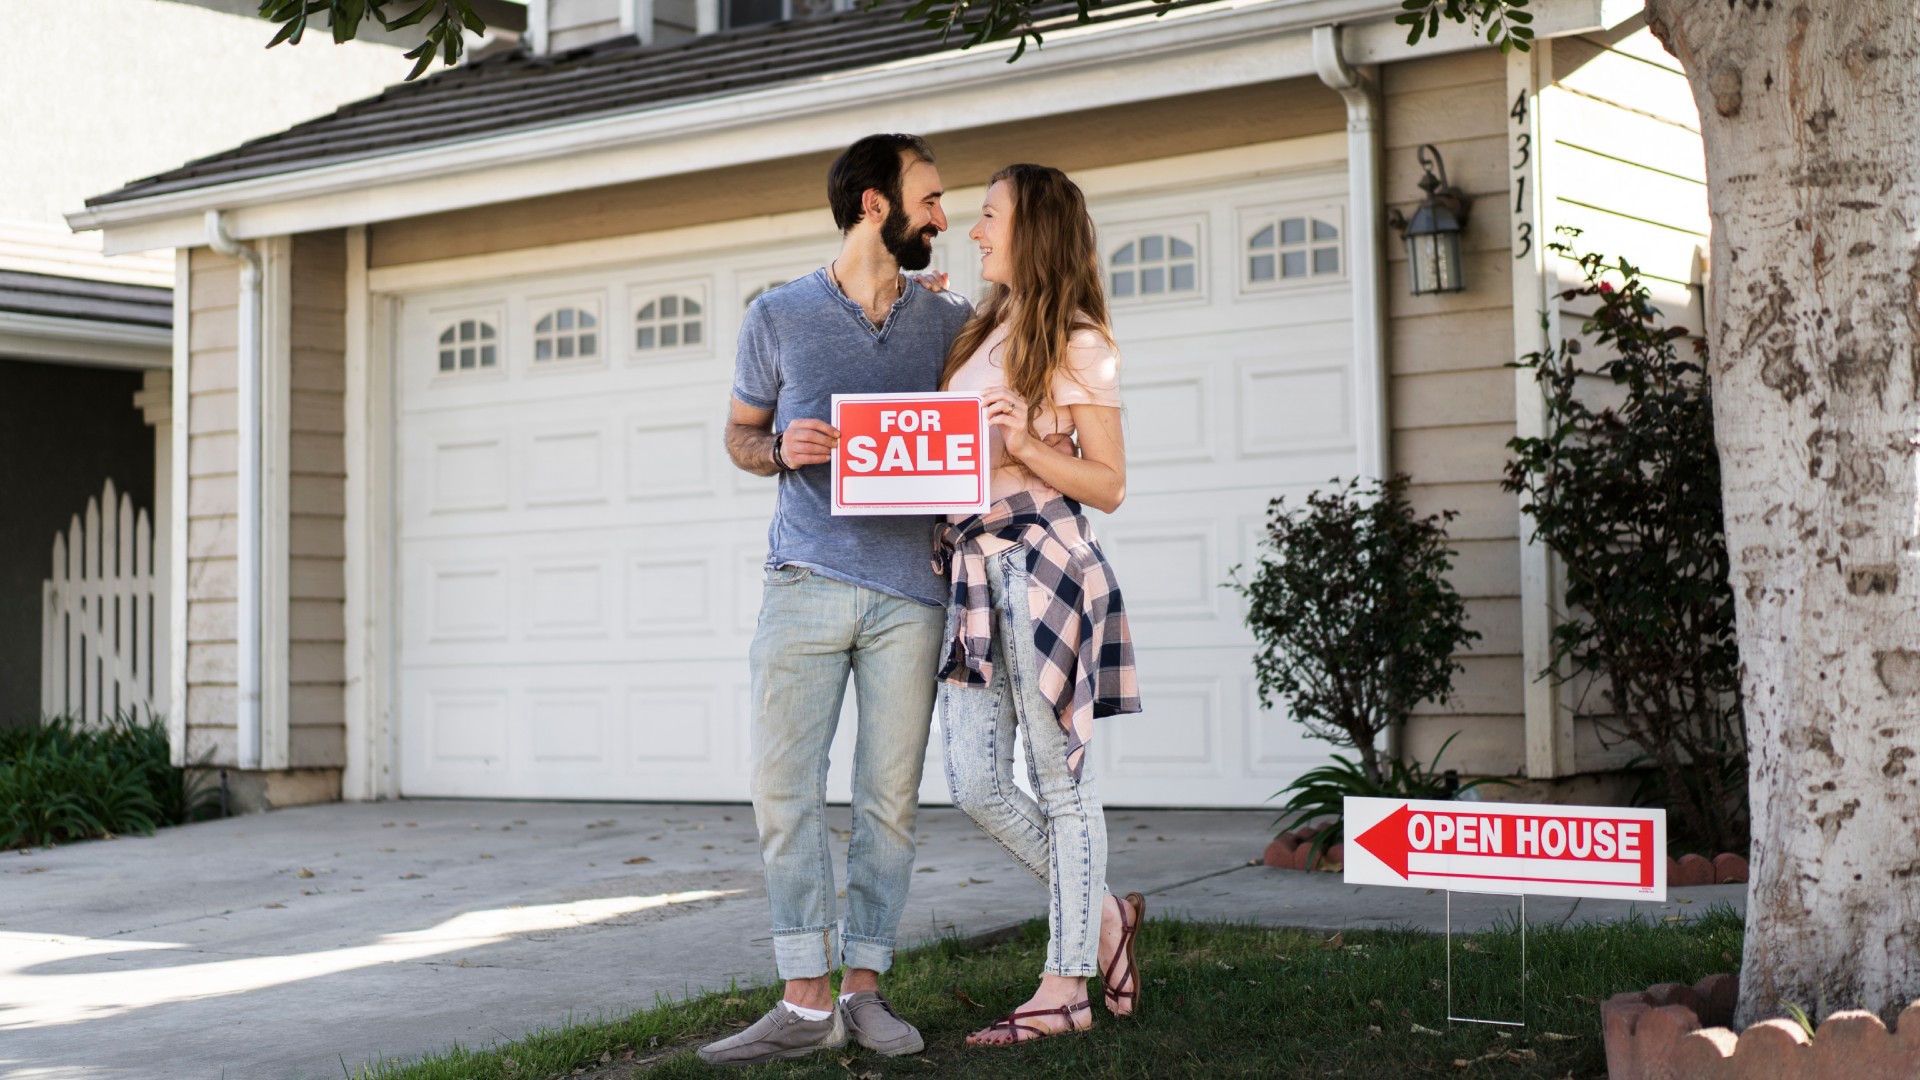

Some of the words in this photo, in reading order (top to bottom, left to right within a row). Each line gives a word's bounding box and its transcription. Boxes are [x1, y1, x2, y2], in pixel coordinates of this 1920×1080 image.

[1510, 88, 1532, 259] 4313
[880, 409, 941, 433] FOR
[846, 434, 976, 473] SALE
[1407, 813, 1503, 854] OPEN
[1515, 818, 1642, 861] HOUSE
